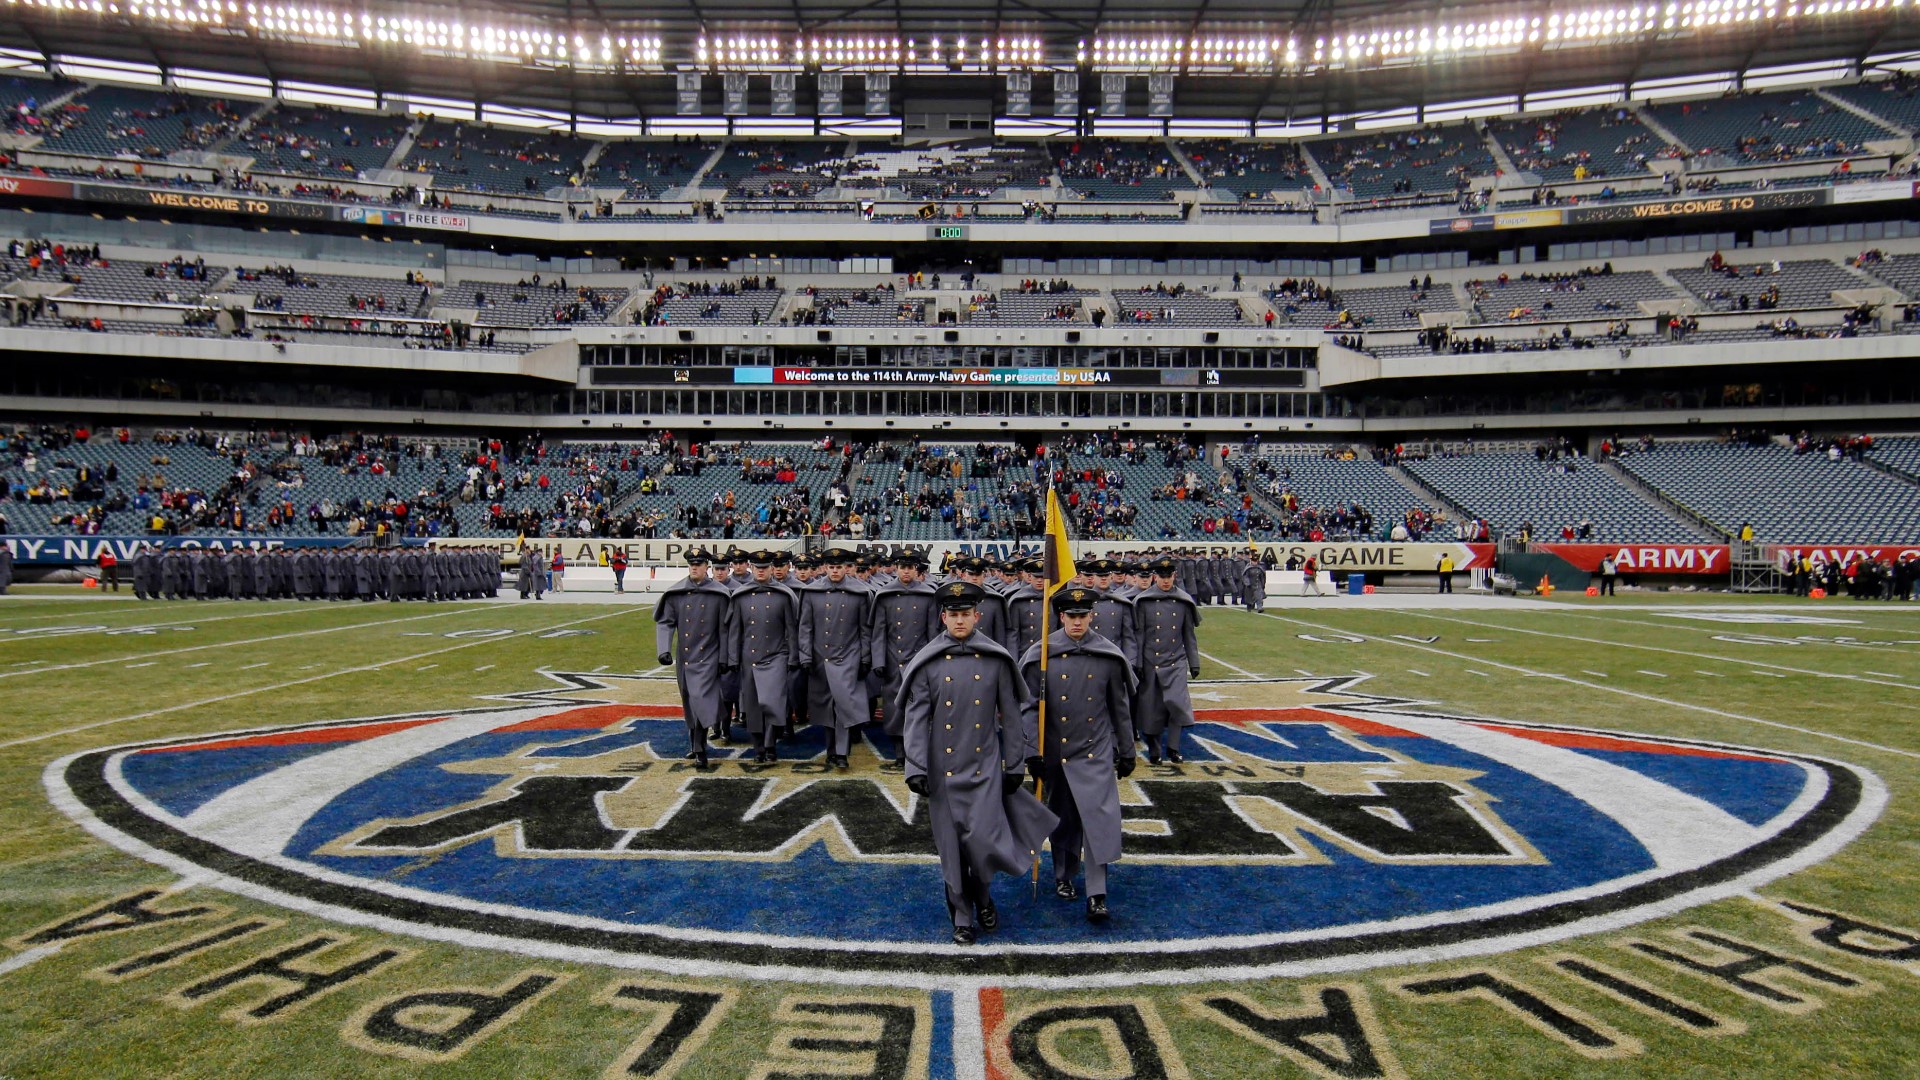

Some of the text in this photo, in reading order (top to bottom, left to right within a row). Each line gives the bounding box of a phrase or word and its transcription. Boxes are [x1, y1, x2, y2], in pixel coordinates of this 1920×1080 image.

[149, 192, 239, 211] WELCOME
[246, 201, 269, 214] TO
[1633, 199, 1722, 217] WELCOME
[1731, 197, 1754, 210] TO
[408, 213, 438, 225] FREE
[941, 227, 961, 238] 0:00
[784, 370, 1110, 384] Welcome to the 114th Army-Navy Game presented by USAA
[1319, 547, 1404, 566] GAME
[1614, 548, 1721, 569] ARMY
[1777, 549, 1881, 570] NAVY
[300, 774, 1515, 860] ARMY
